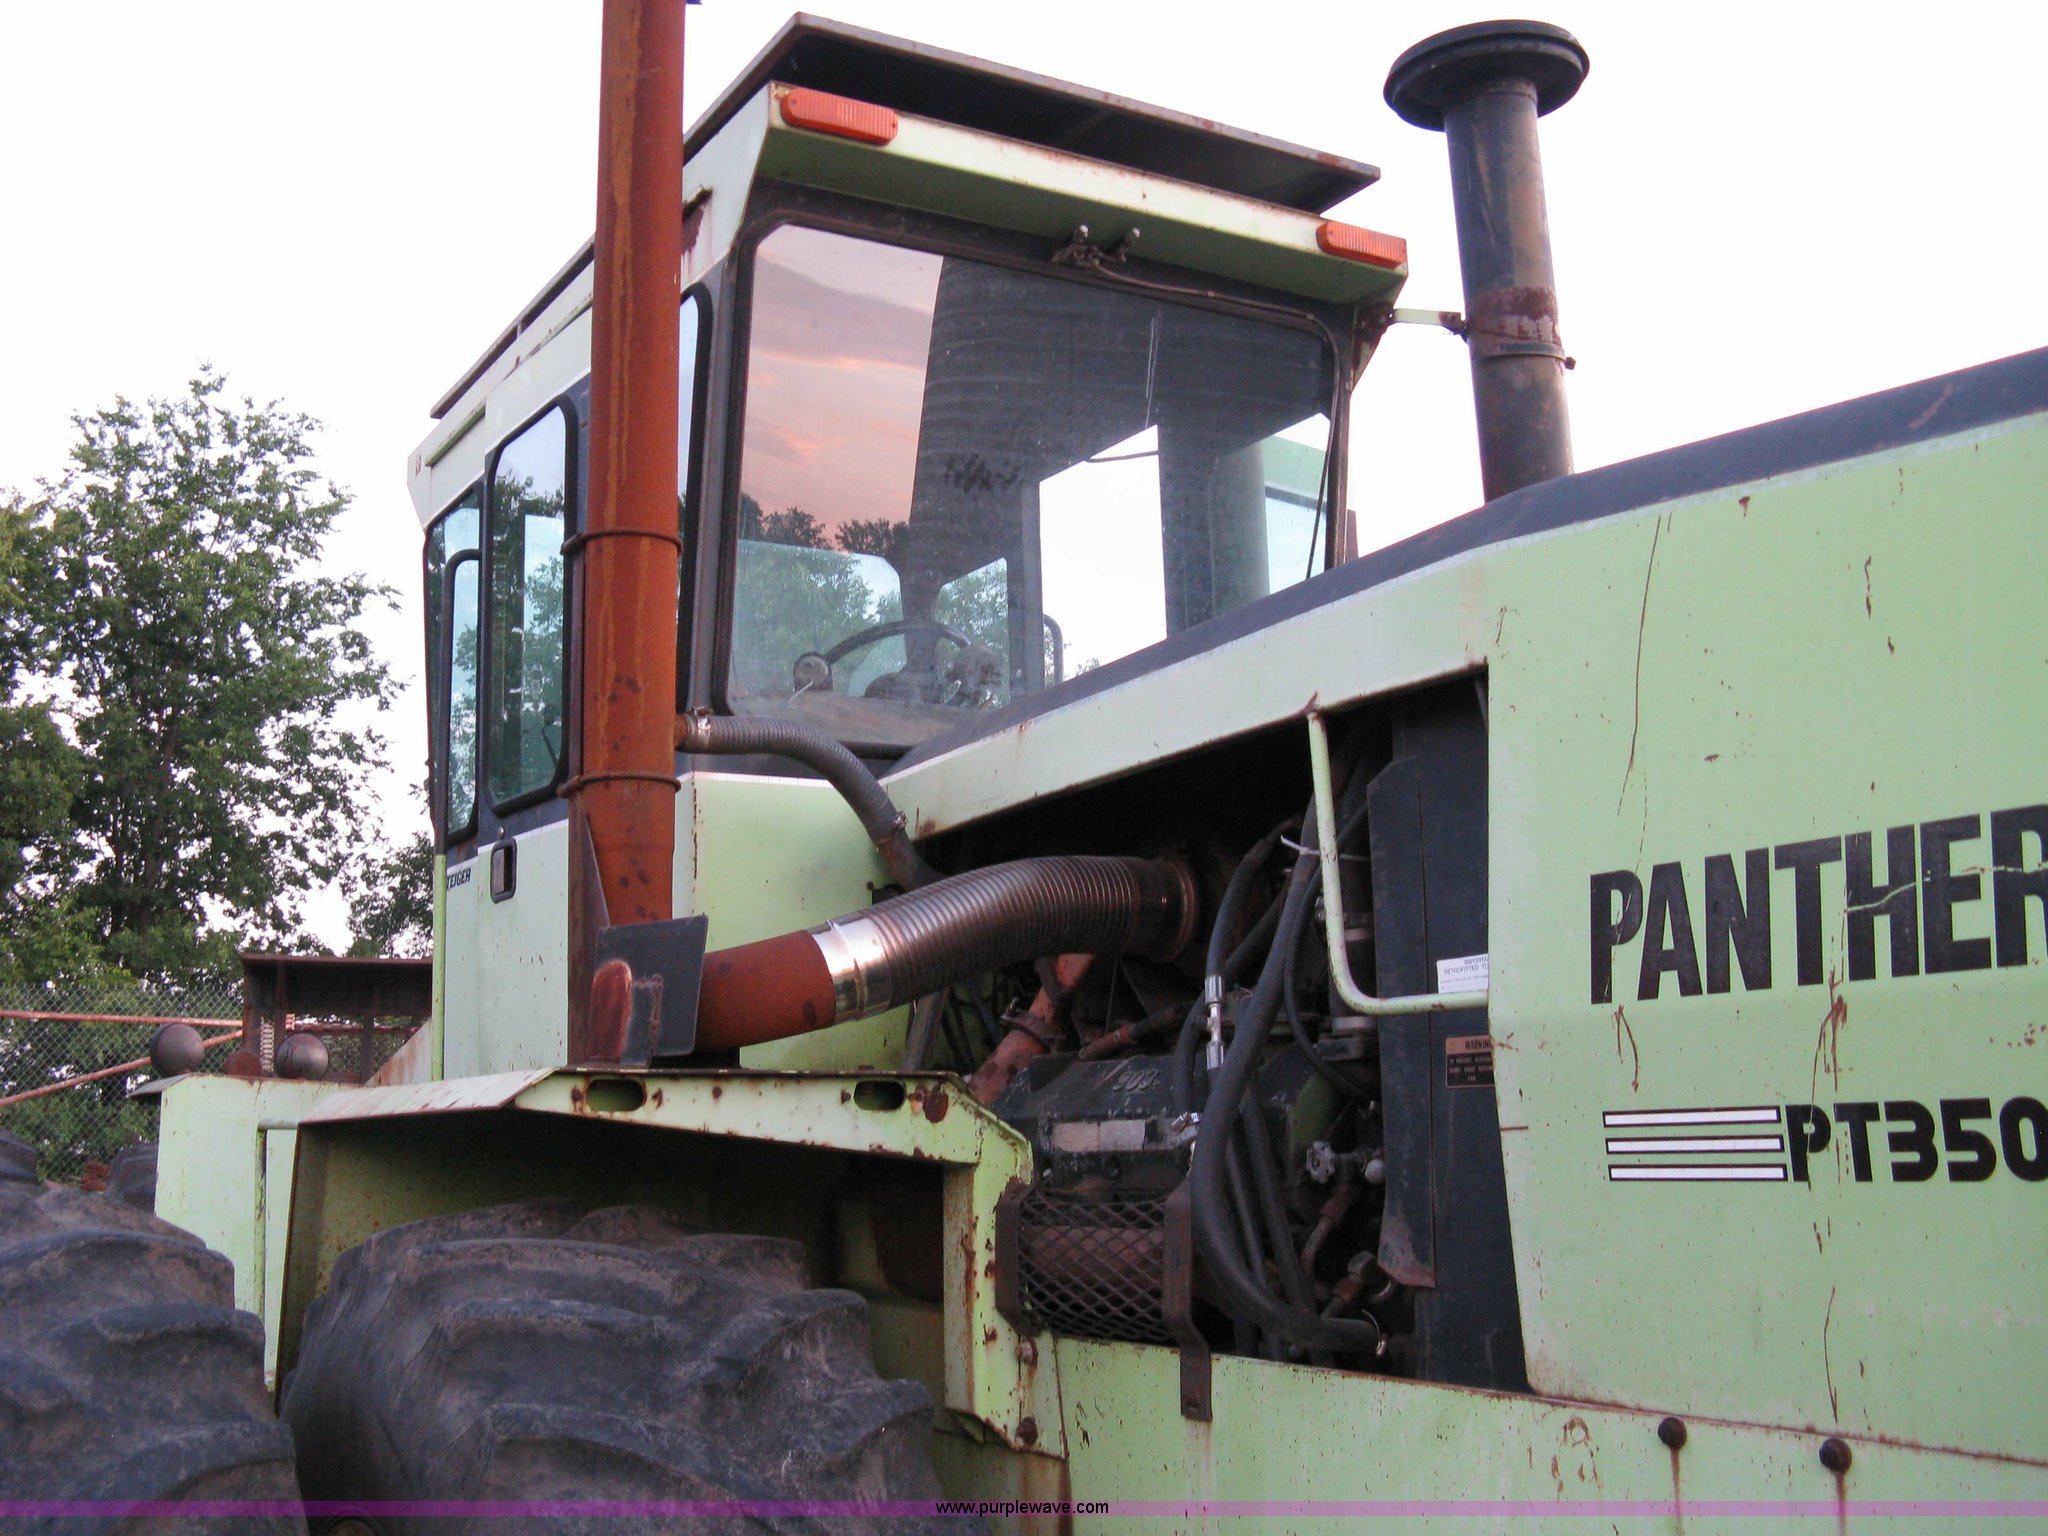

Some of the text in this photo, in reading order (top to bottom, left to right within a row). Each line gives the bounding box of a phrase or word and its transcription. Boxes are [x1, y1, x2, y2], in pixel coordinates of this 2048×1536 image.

[446, 867, 471, 890] TEIGER
[1590, 804, 2048, 1005] PANTHER
[1465, 1039, 1489, 1050] WARNIN
[1785, 1096, 2048, 1182] PT350
